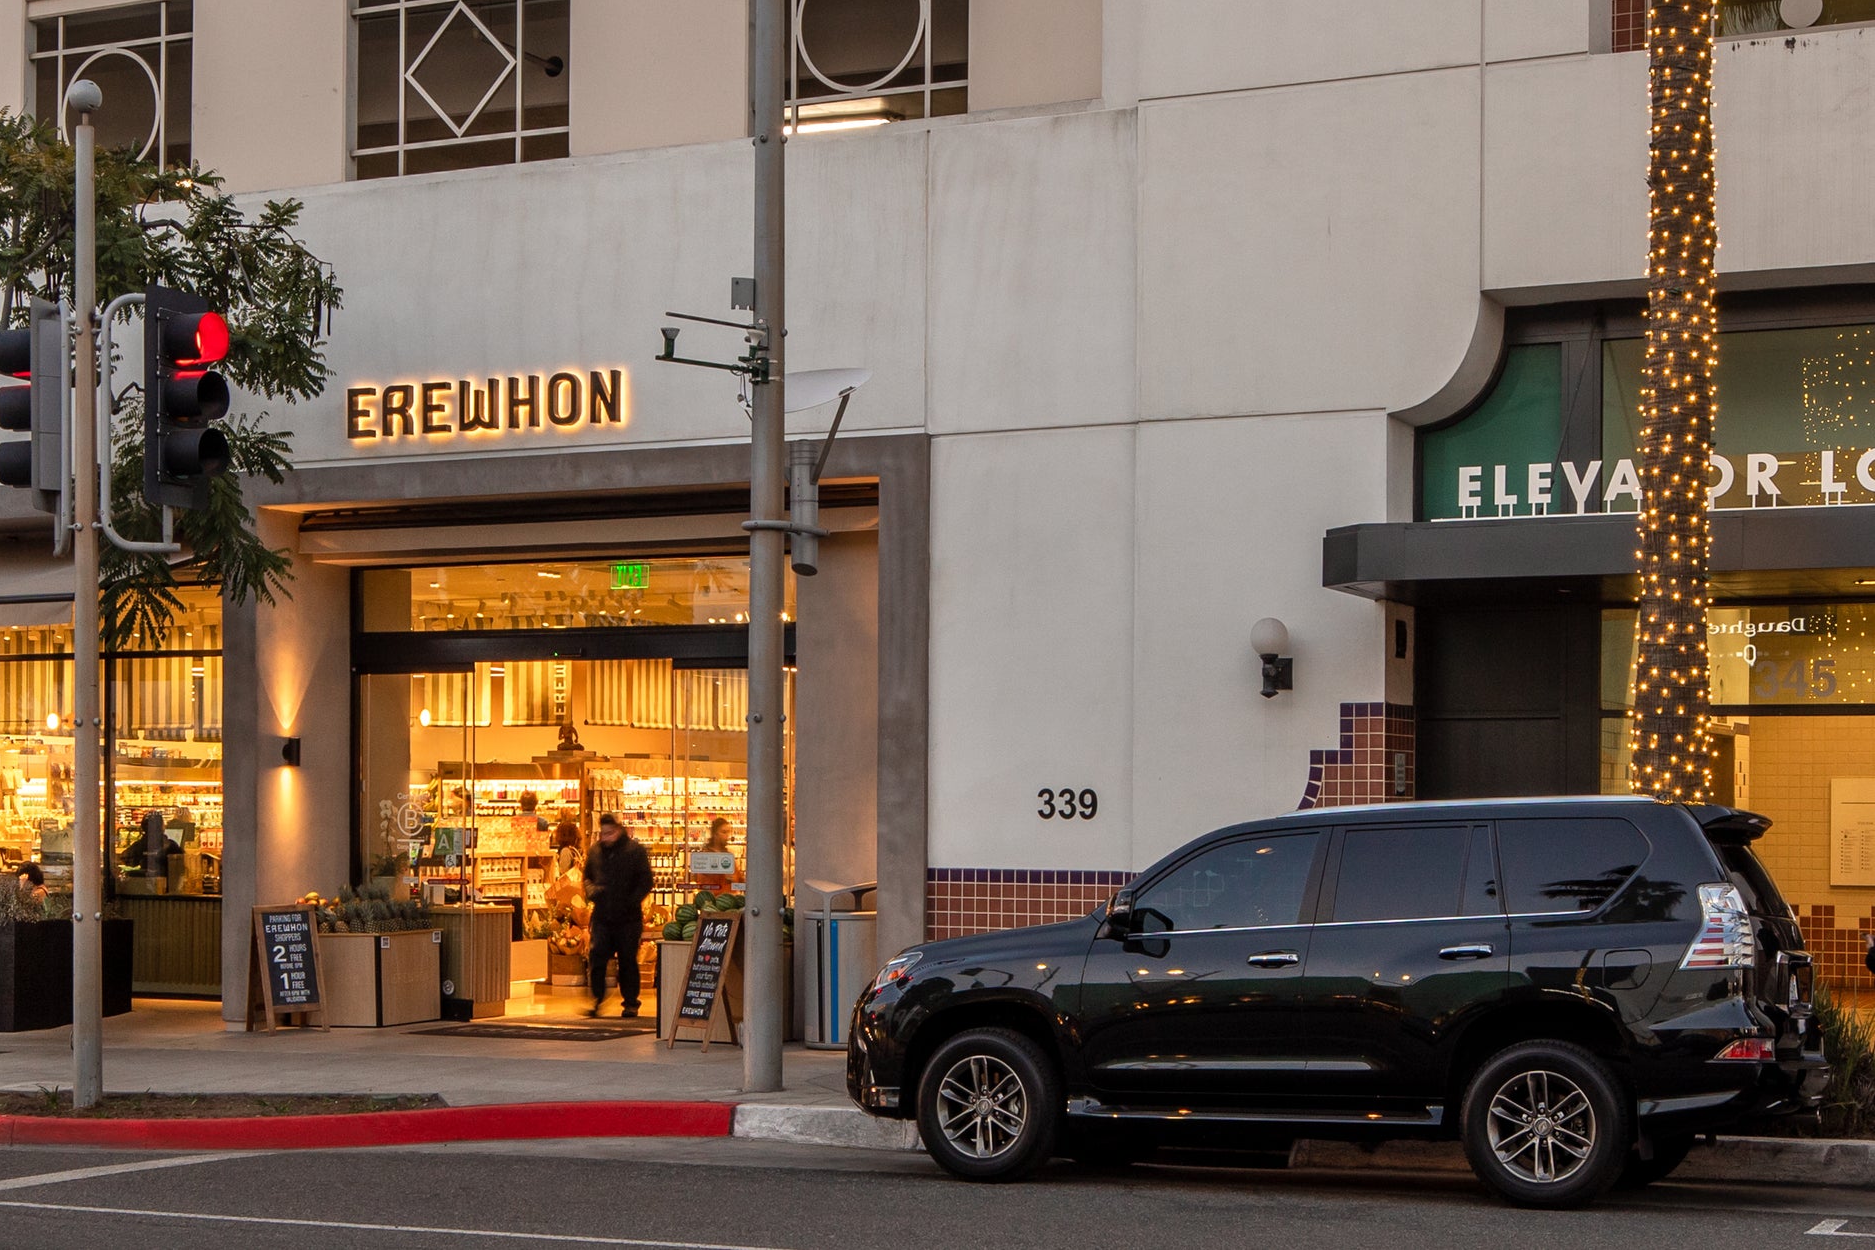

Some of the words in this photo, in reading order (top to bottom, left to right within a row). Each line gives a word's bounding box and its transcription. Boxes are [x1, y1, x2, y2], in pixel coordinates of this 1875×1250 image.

[347, 369, 622, 440] EREWHON
[1458, 454, 1782, 507] ELEVAOR
[1754, 659, 1837, 699] 345
[1037, 788, 1098, 820] 339
[437, 833, 450, 849] A
[269, 914, 291, 923] PARKING
[291, 914, 302, 922] FOR
[265, 923, 308, 933] EREWHON
[703, 921, 713, 937] No
[713, 922, 728, 938] Pets
[274, 933, 301, 942] SHOPPERS
[272, 945, 287, 963] 2
[289, 943, 307, 952] HOURS
[290, 953, 303, 962] FREE
[280, 973, 289, 990] 1
[290, 971, 305, 980] HOUR
[292, 980, 305, 989] FREE
[681, 1006, 704, 1016] EREWHON
